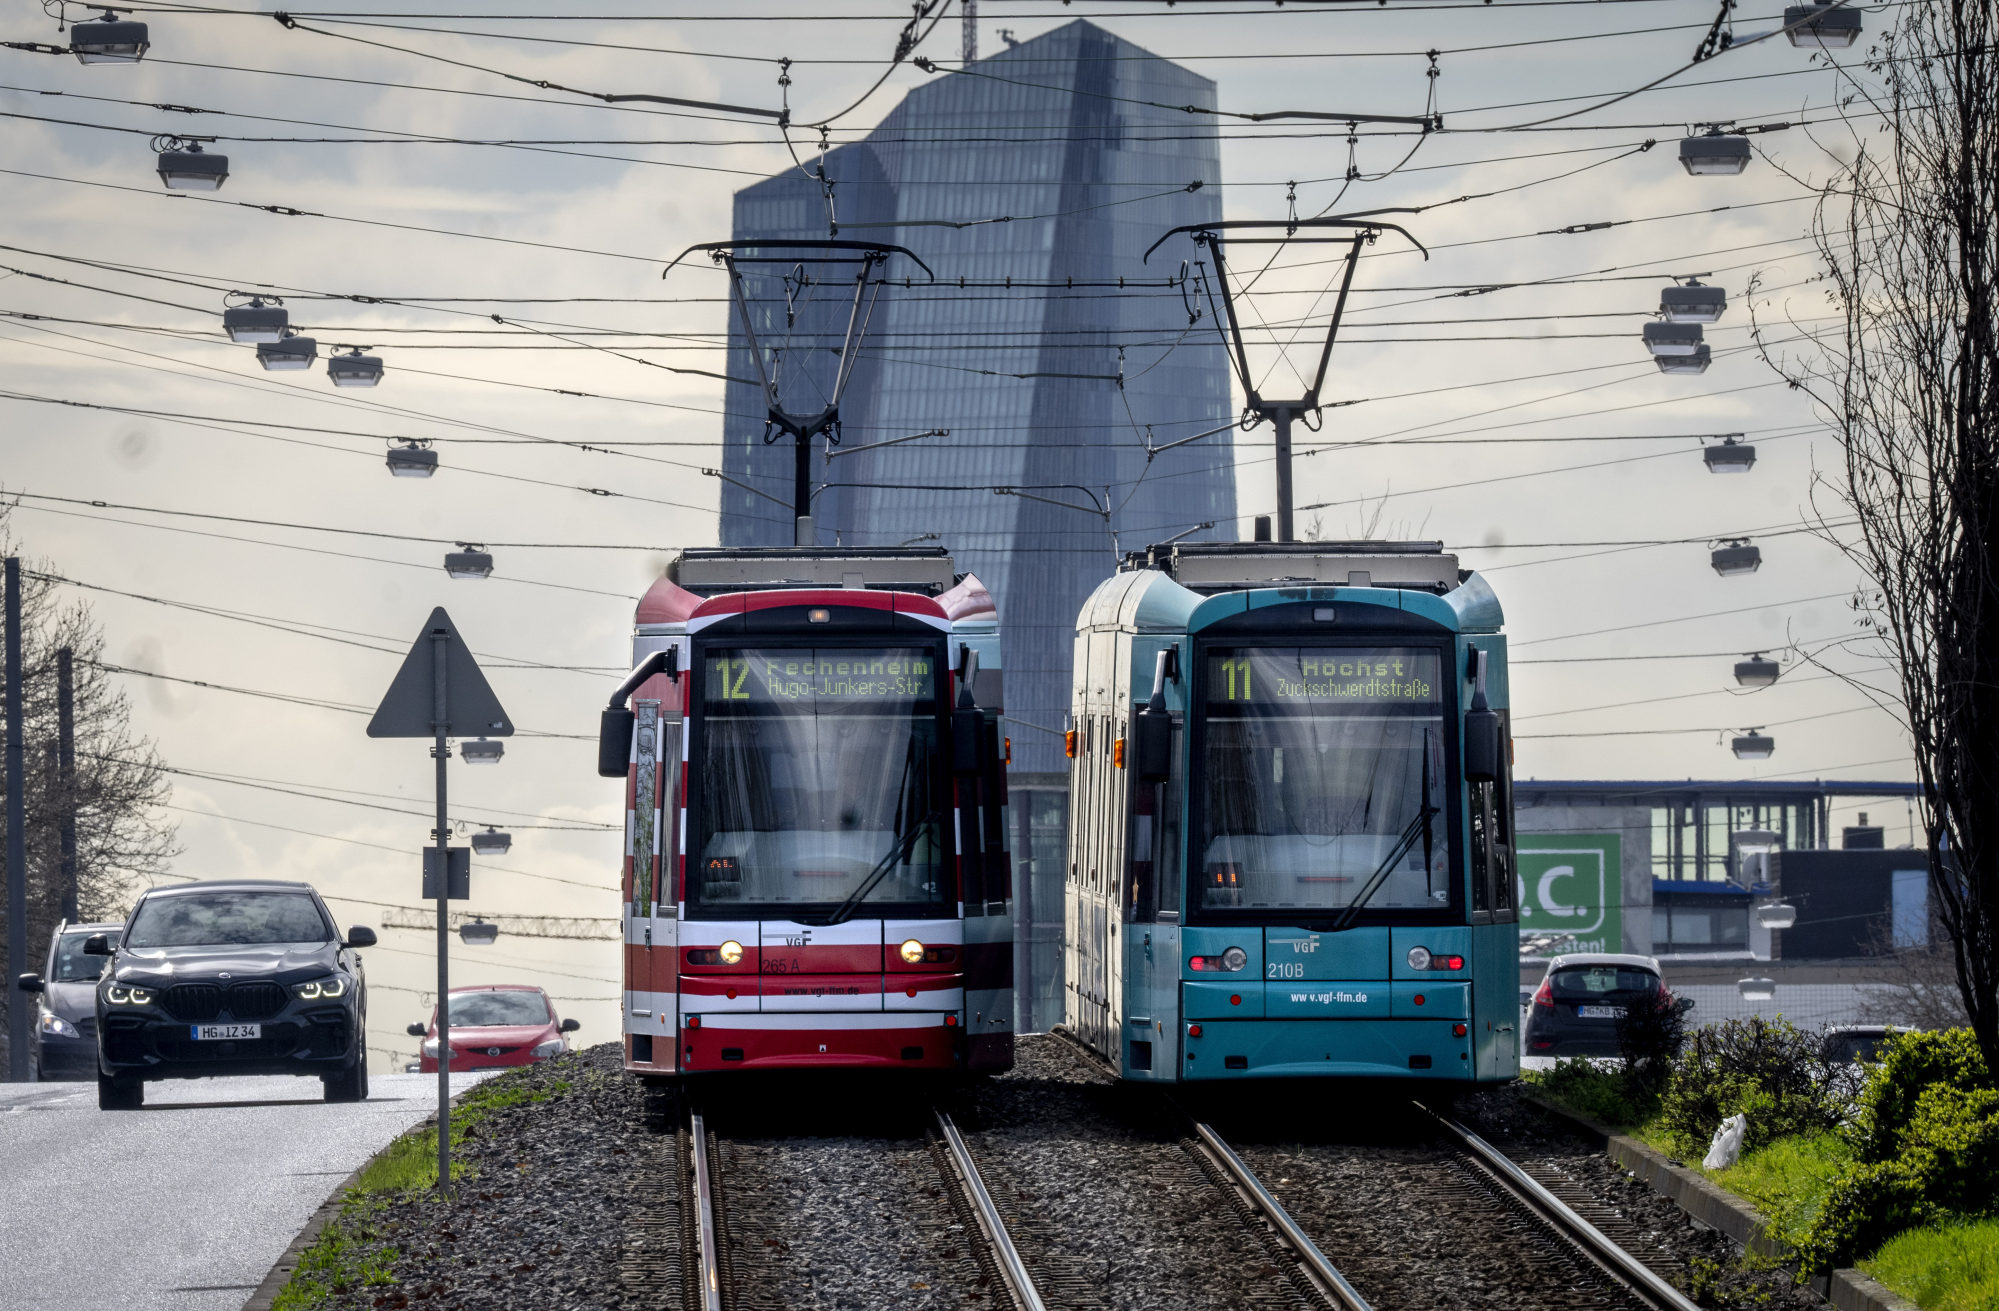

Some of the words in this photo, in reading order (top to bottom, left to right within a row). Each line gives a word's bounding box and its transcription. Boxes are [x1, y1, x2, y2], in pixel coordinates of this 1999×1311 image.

[1303, 658, 1404, 676] Höchst
[716, 658, 750, 699] 12
[1222, 658, 1250, 700] 11
[768, 677, 927, 699] Hugo-Junkers-Str.
[1277, 678, 1430, 700] Zuckschwerdtstraße
[1517, 865, 1588, 917] .C.
[786, 930, 812, 948] VGF
[1293, 934, 1320, 953] VGF
[762, 958, 787, 974] 265
[791, 958, 800, 973] A
[1268, 962, 1304, 978] 210B
[784, 985, 860, 998] www.vgf-ffm.de
[202, 1027, 218, 1038] HG
[225, 1026, 239, 1038] IZ
[241, 1025, 255, 1037] 34
